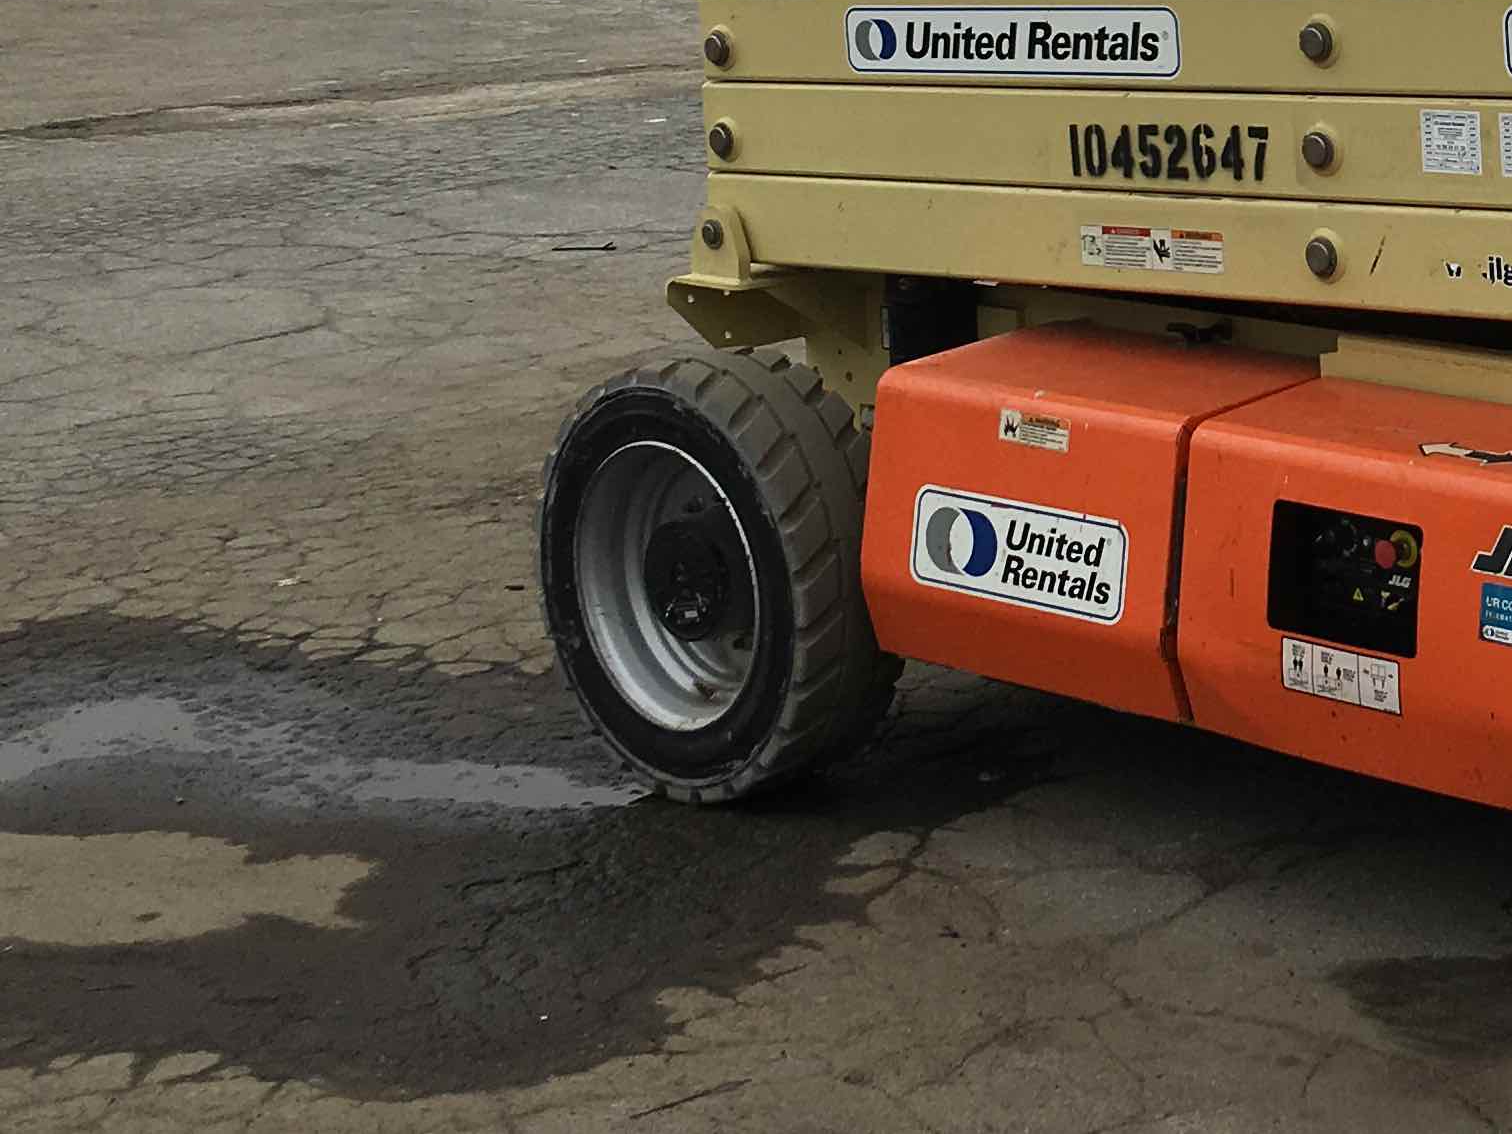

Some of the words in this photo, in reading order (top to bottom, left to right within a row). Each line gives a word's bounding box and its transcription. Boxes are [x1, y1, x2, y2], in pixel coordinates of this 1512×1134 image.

[905, 21, 1017, 60] United
[1028, 21, 1159, 61] Rentals
[1006, 520, 1105, 568] United
[1001, 555, 1111, 605] Rentals
[1389, 574, 1412, 588] JLG
[1486, 596, 1500, 609] UR
